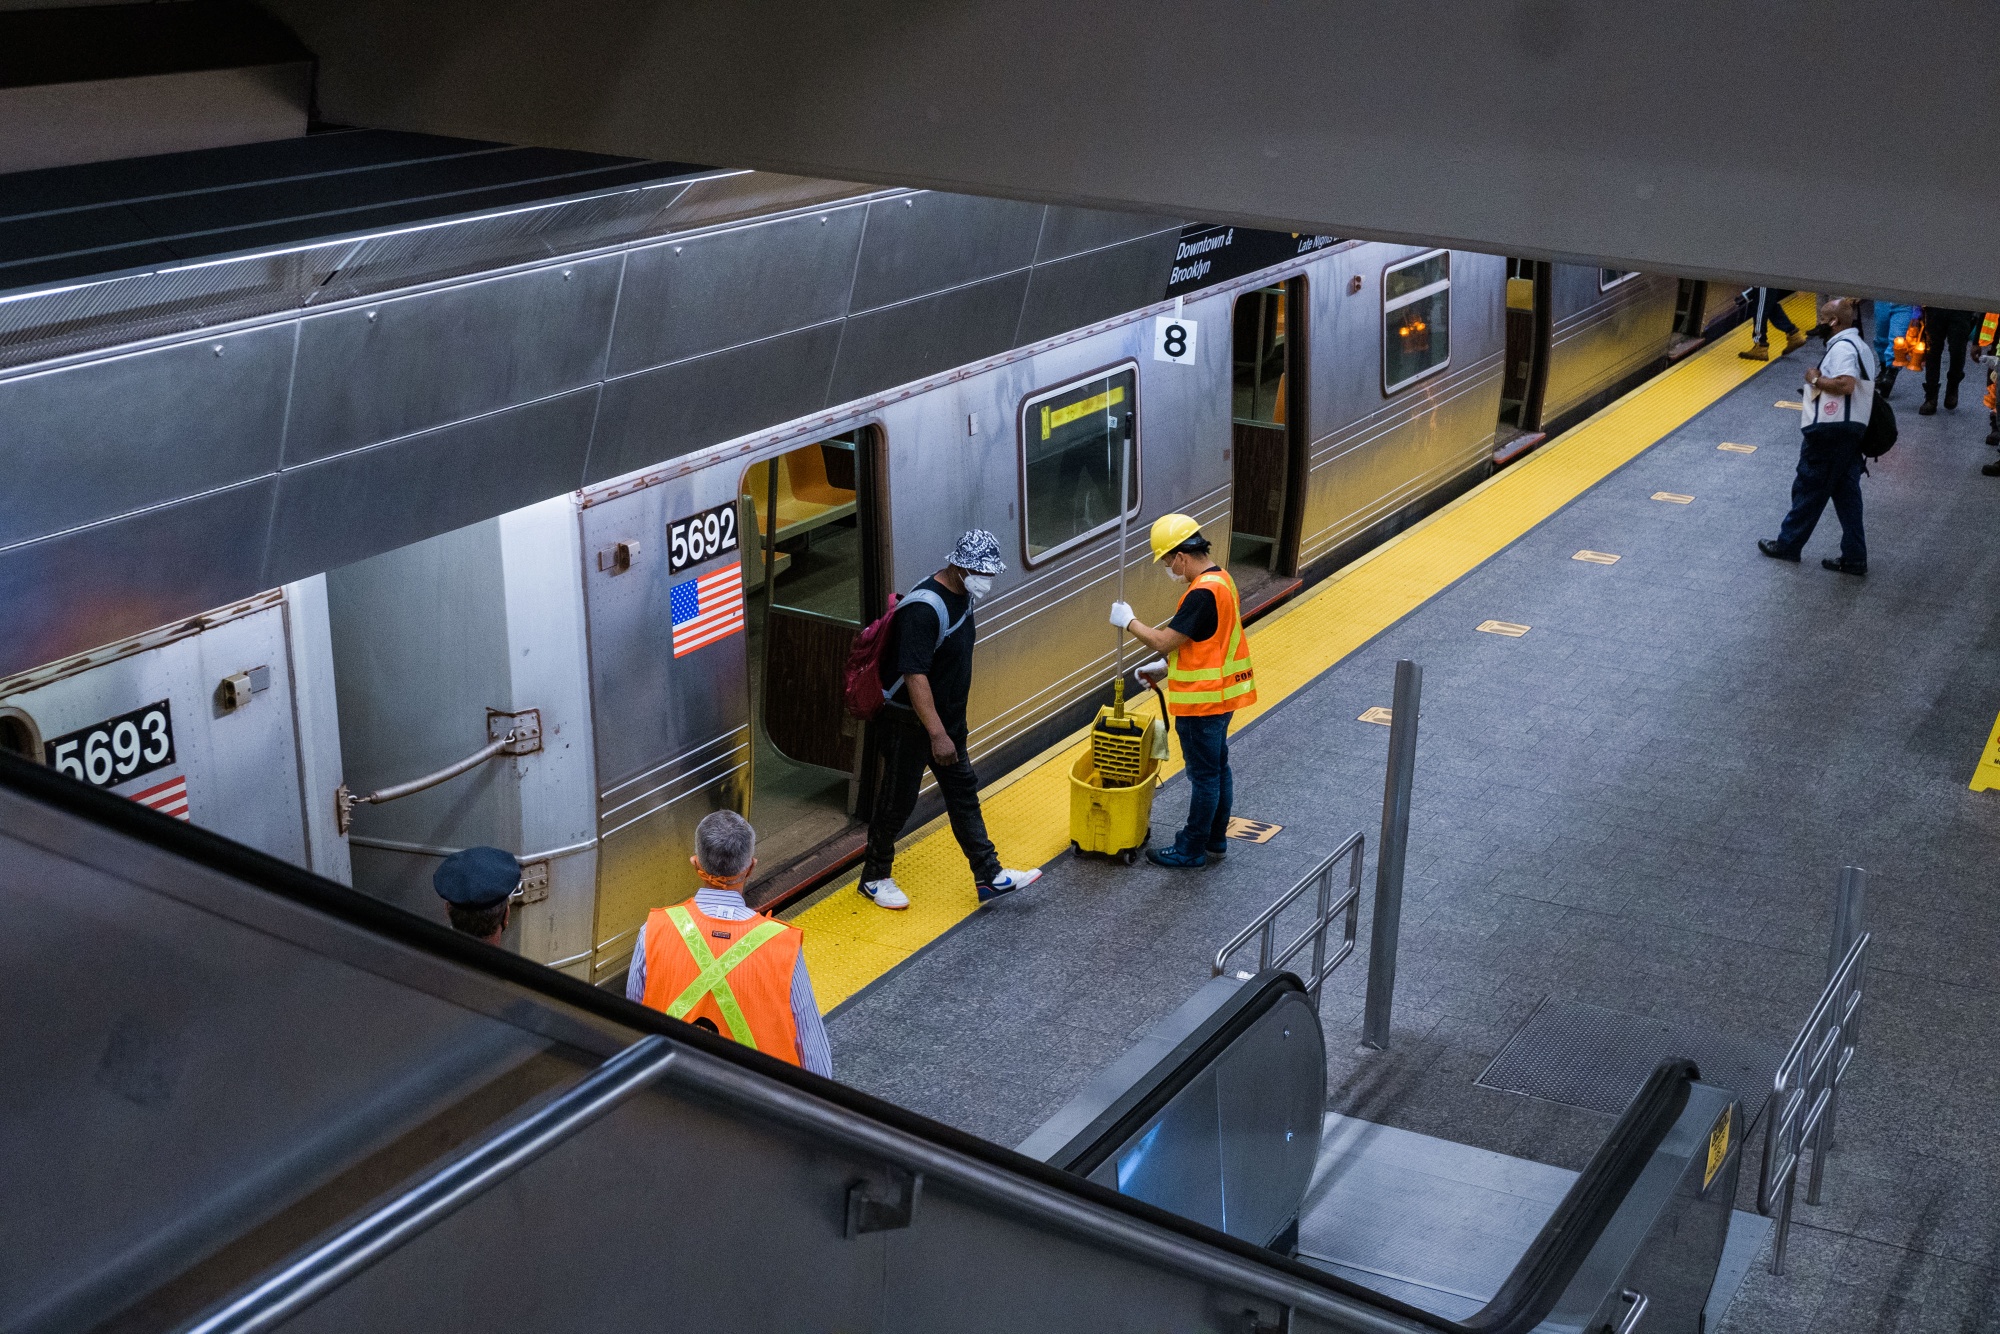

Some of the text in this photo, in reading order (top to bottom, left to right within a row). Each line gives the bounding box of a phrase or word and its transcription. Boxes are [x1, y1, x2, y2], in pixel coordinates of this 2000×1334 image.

[1176, 228, 1234, 260] Downtown &
[1297, 238, 1313, 253] Late
[1169, 259, 1211, 285] Brooklyn
[1163, 324, 1187, 357] 8
[671, 507, 736, 567] 5692
[55, 710, 170, 785] 5693
